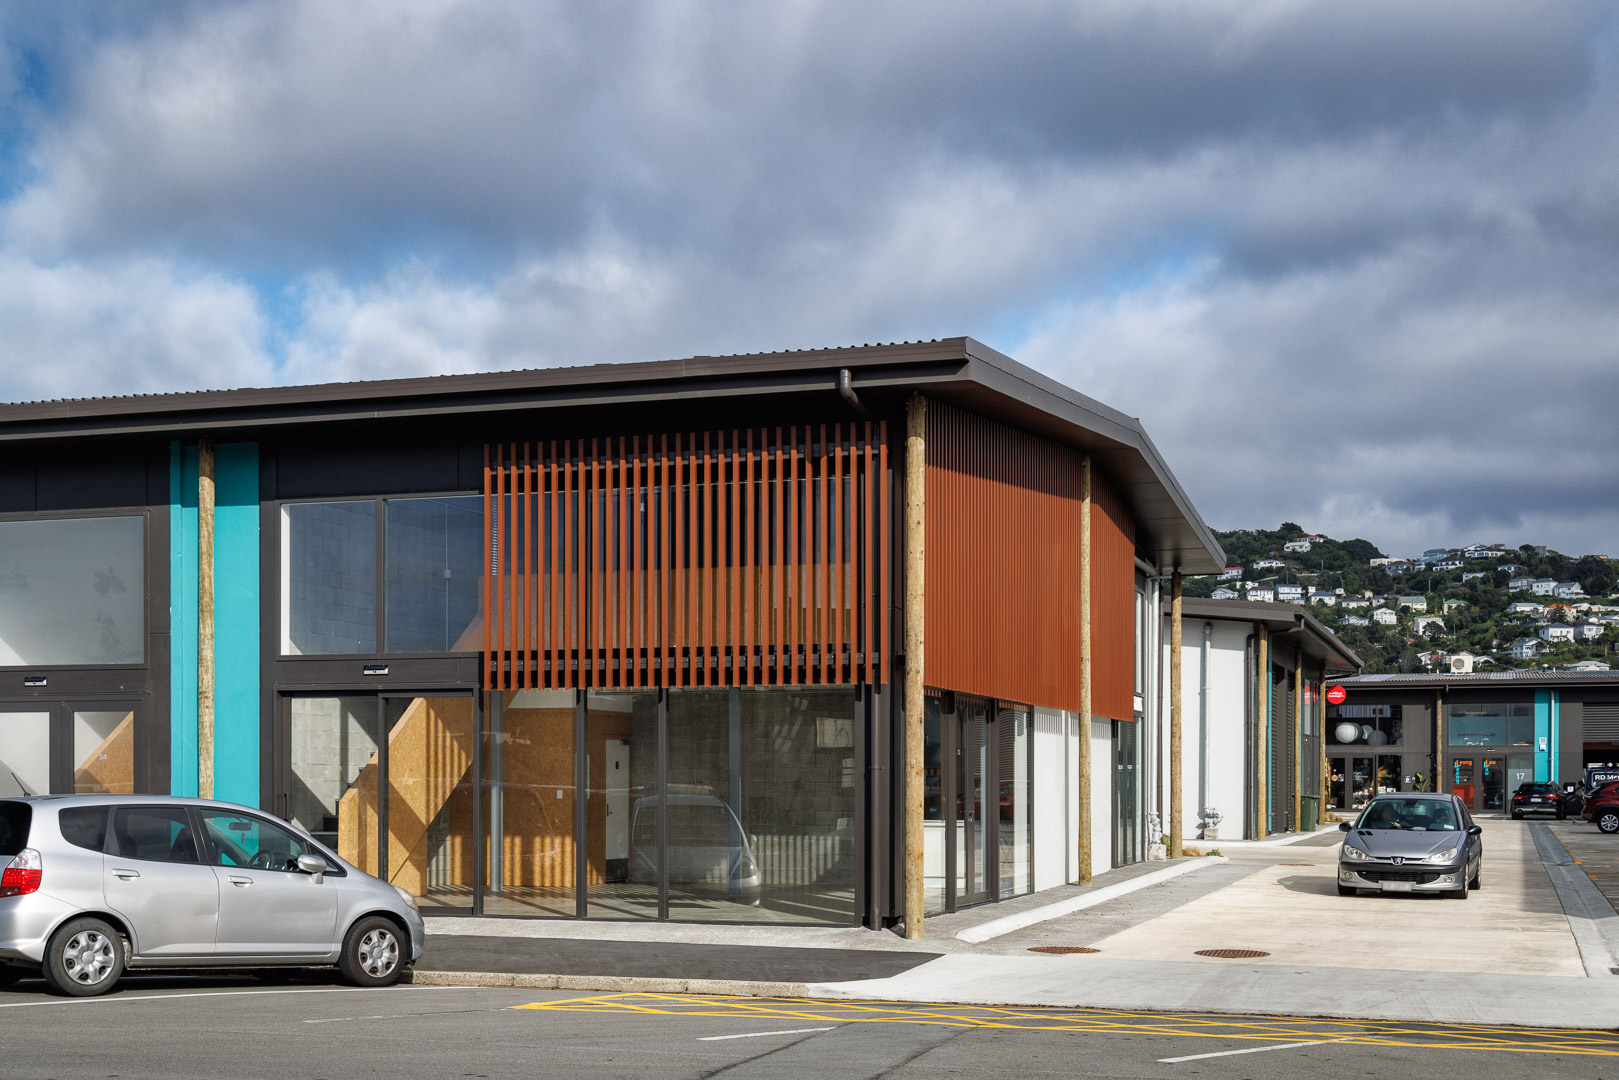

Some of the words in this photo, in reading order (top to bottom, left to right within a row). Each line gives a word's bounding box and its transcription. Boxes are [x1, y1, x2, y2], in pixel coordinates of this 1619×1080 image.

[1456, 759, 1472, 767] Leong
[1485, 759, 1496, 767] Law
[1515, 772, 1525, 780] 17
